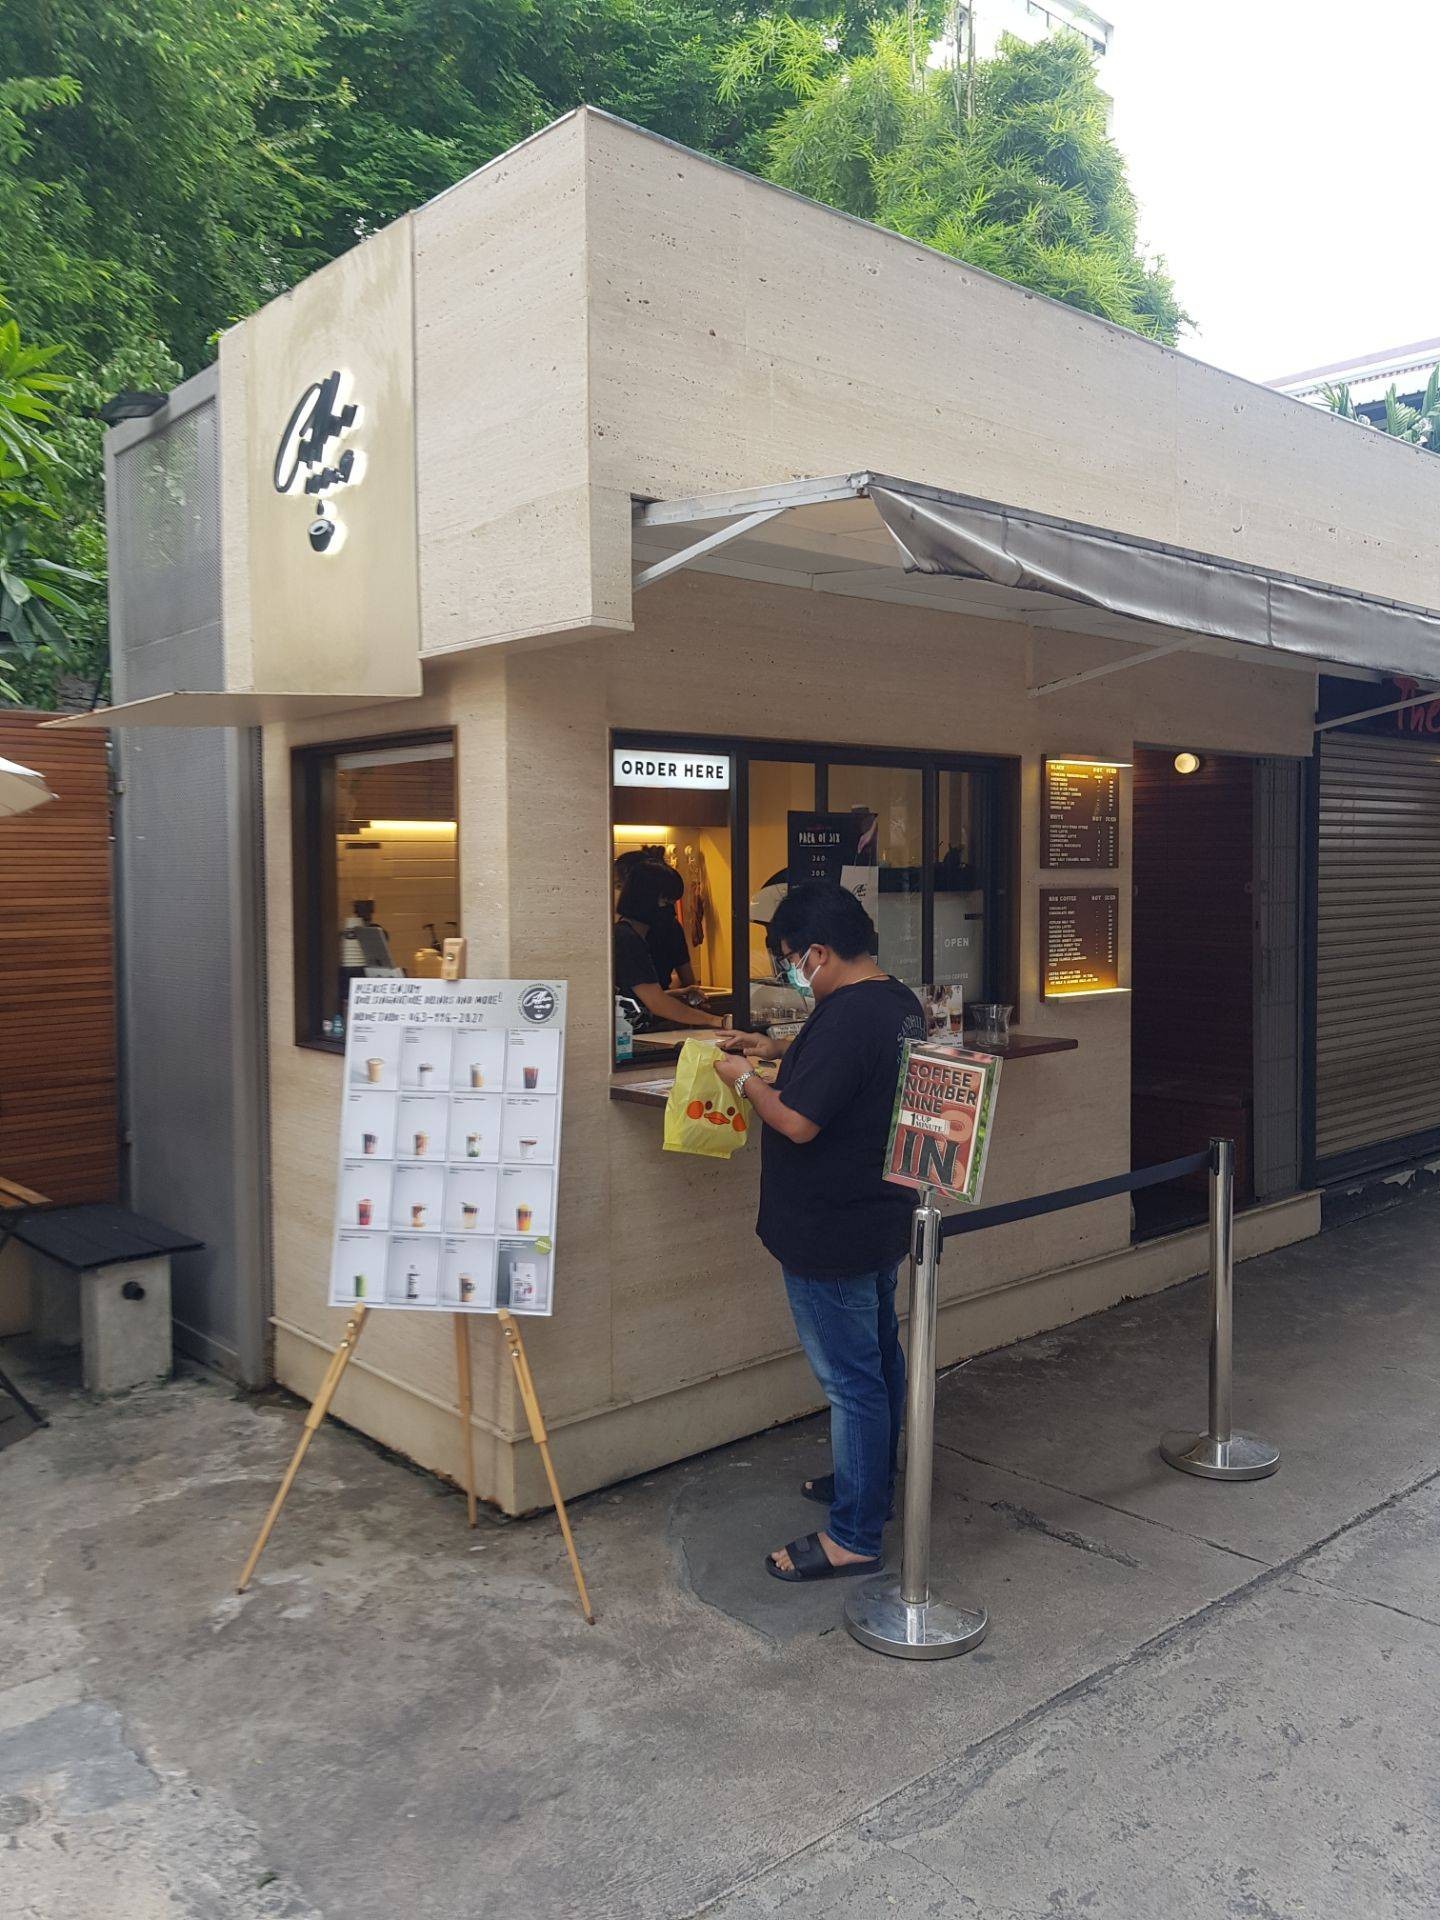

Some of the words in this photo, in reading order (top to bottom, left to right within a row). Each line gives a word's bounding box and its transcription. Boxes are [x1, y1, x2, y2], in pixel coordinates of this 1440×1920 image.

[621, 760, 677, 777] ORDER
[684, 764, 725, 779] HERE
[799, 832, 816, 844] PACK
[944, 937, 969, 948] OPEN
[907, 1063, 973, 1089] COFFEE
[902, 1091, 944, 1115] NINE
[903, 1076, 978, 1106] NUMBER
[894, 1128, 960, 1185] IN
